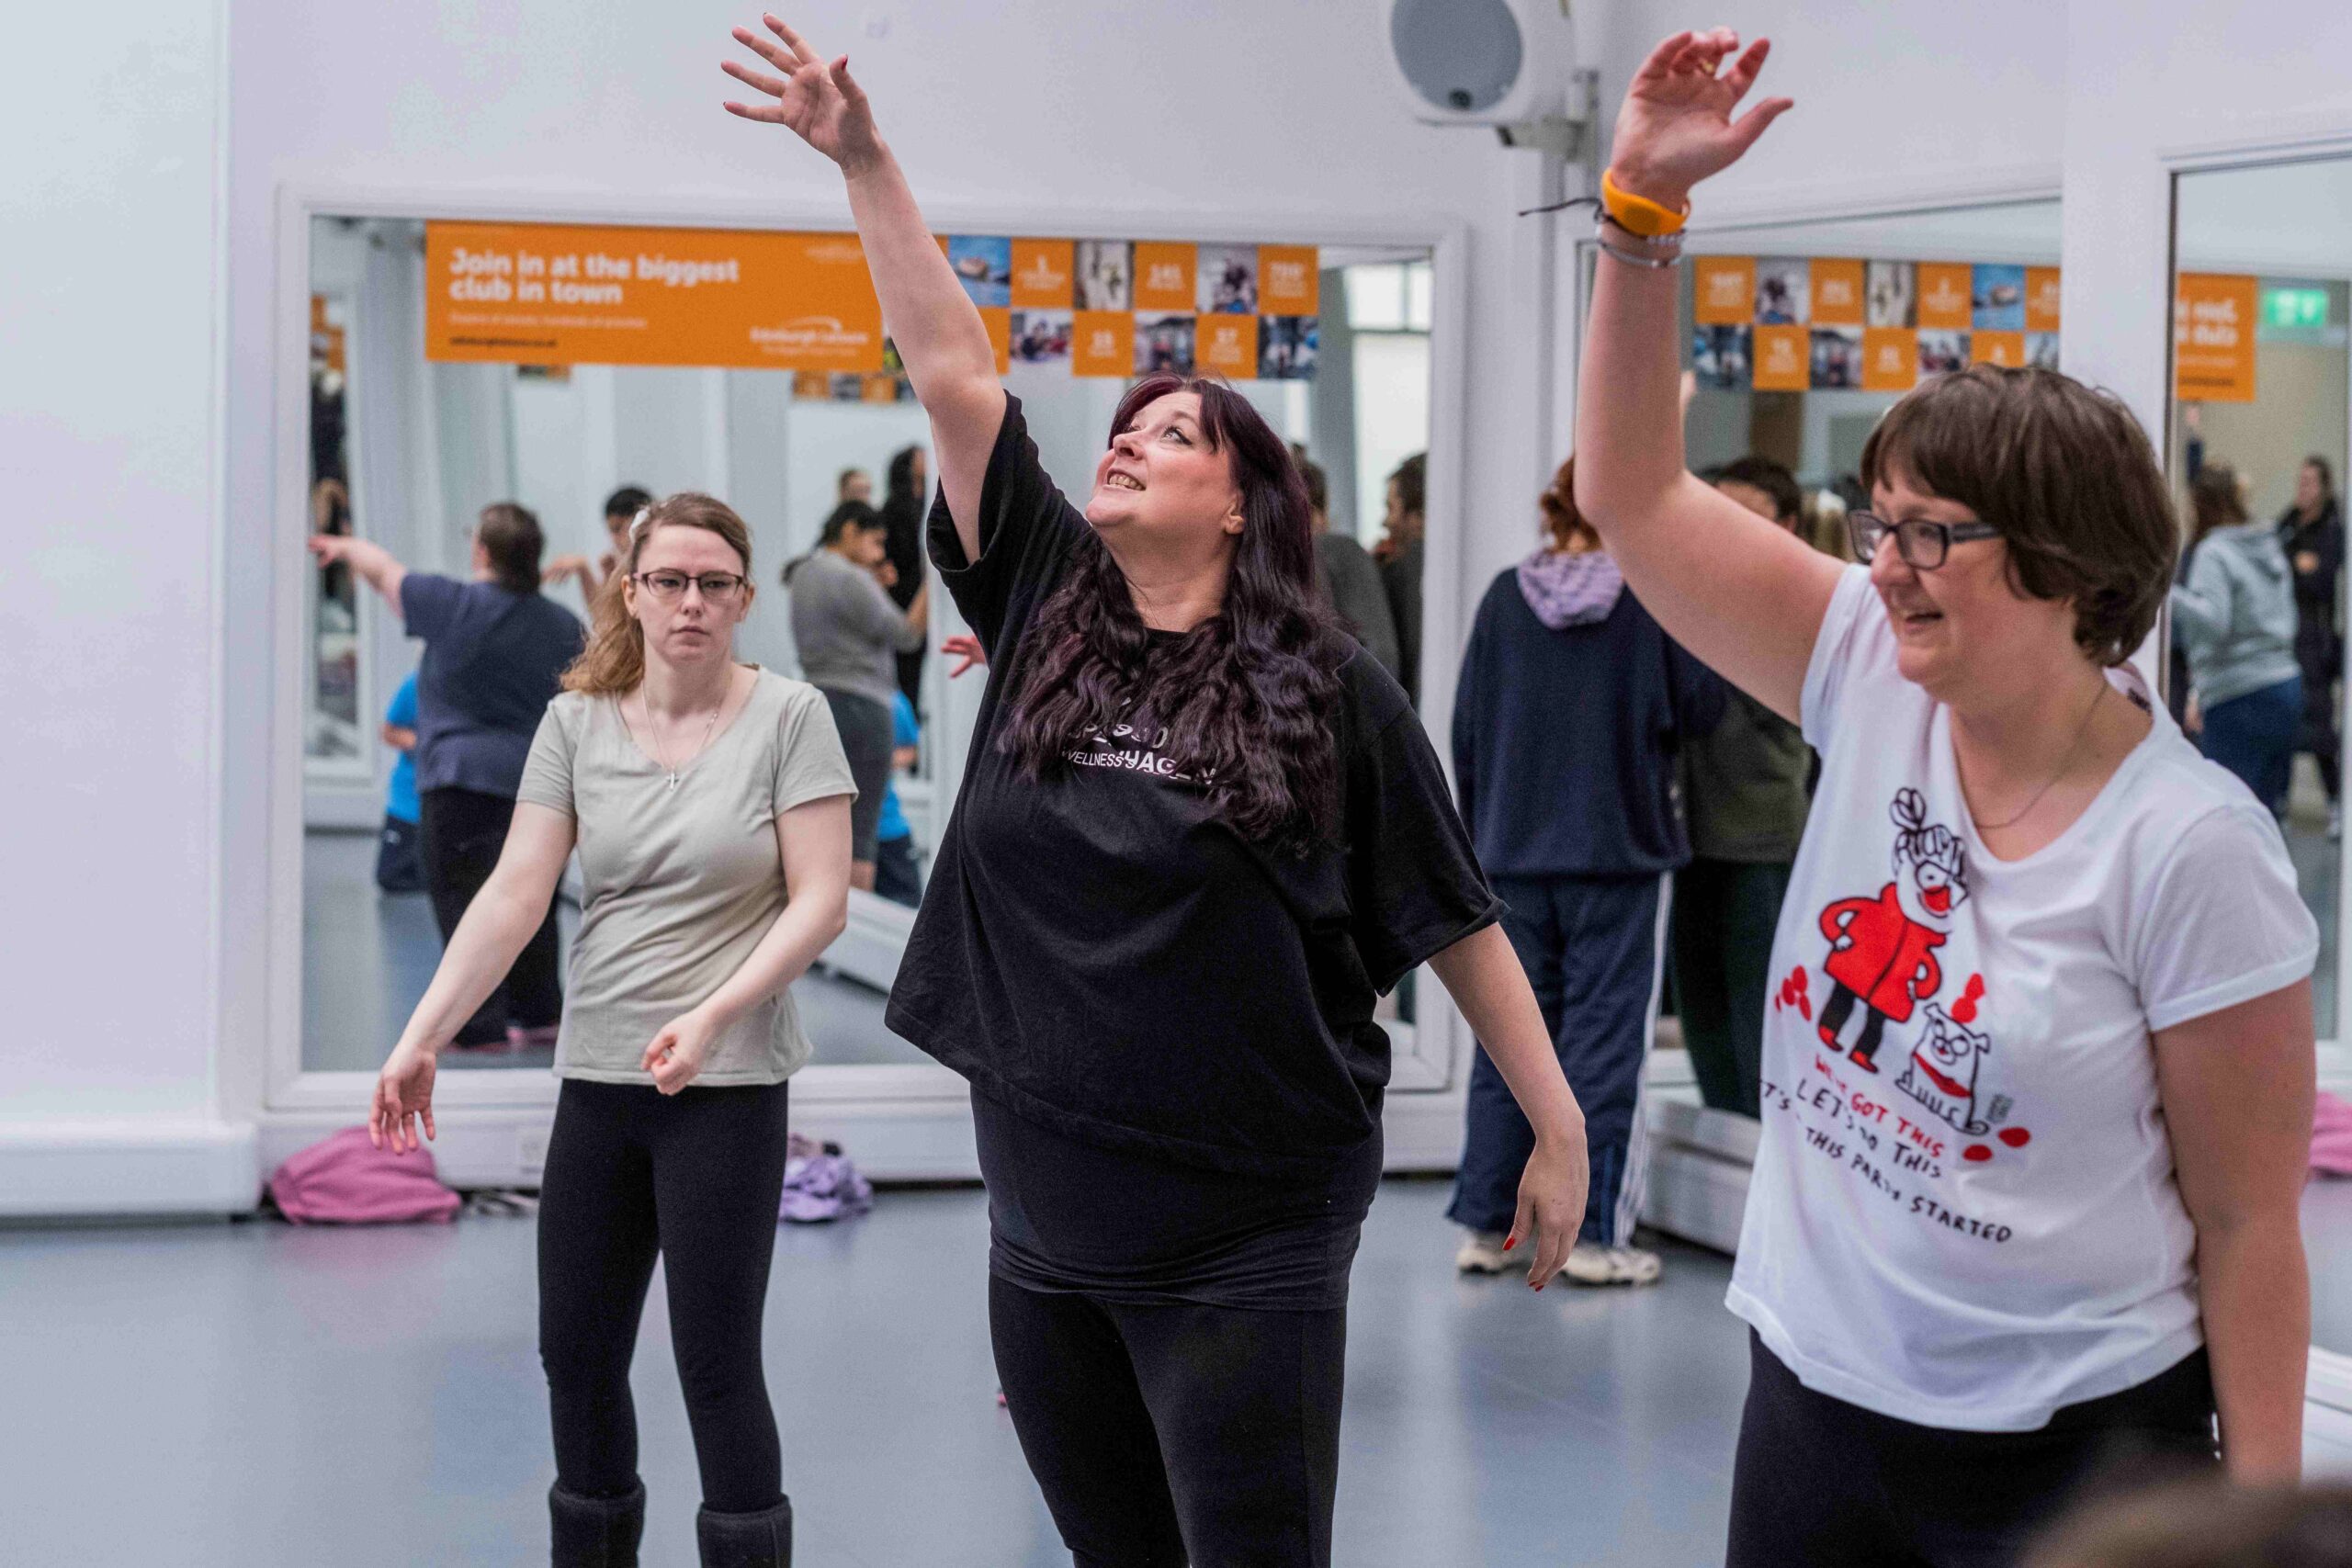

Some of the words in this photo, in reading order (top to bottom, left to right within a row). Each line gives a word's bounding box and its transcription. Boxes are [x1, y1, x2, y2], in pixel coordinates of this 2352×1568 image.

[449, 247, 512, 275] Join
[517, 249, 546, 276] in
[550, 254, 579, 276] at
[584, 253, 631, 279] the
[636, 254, 740, 288] biggest
[449, 276, 512, 301] club
[517, 277, 546, 302] in
[551, 279, 624, 304] town
[1850, 1092, 1889, 1123] GOT
[1897, 1117, 1944, 1157] THIS
[1894, 1141, 1941, 1178] THIS
[1806, 1126, 1845, 1159] THIS
[1910, 1196, 2012, 1243] STARTED
